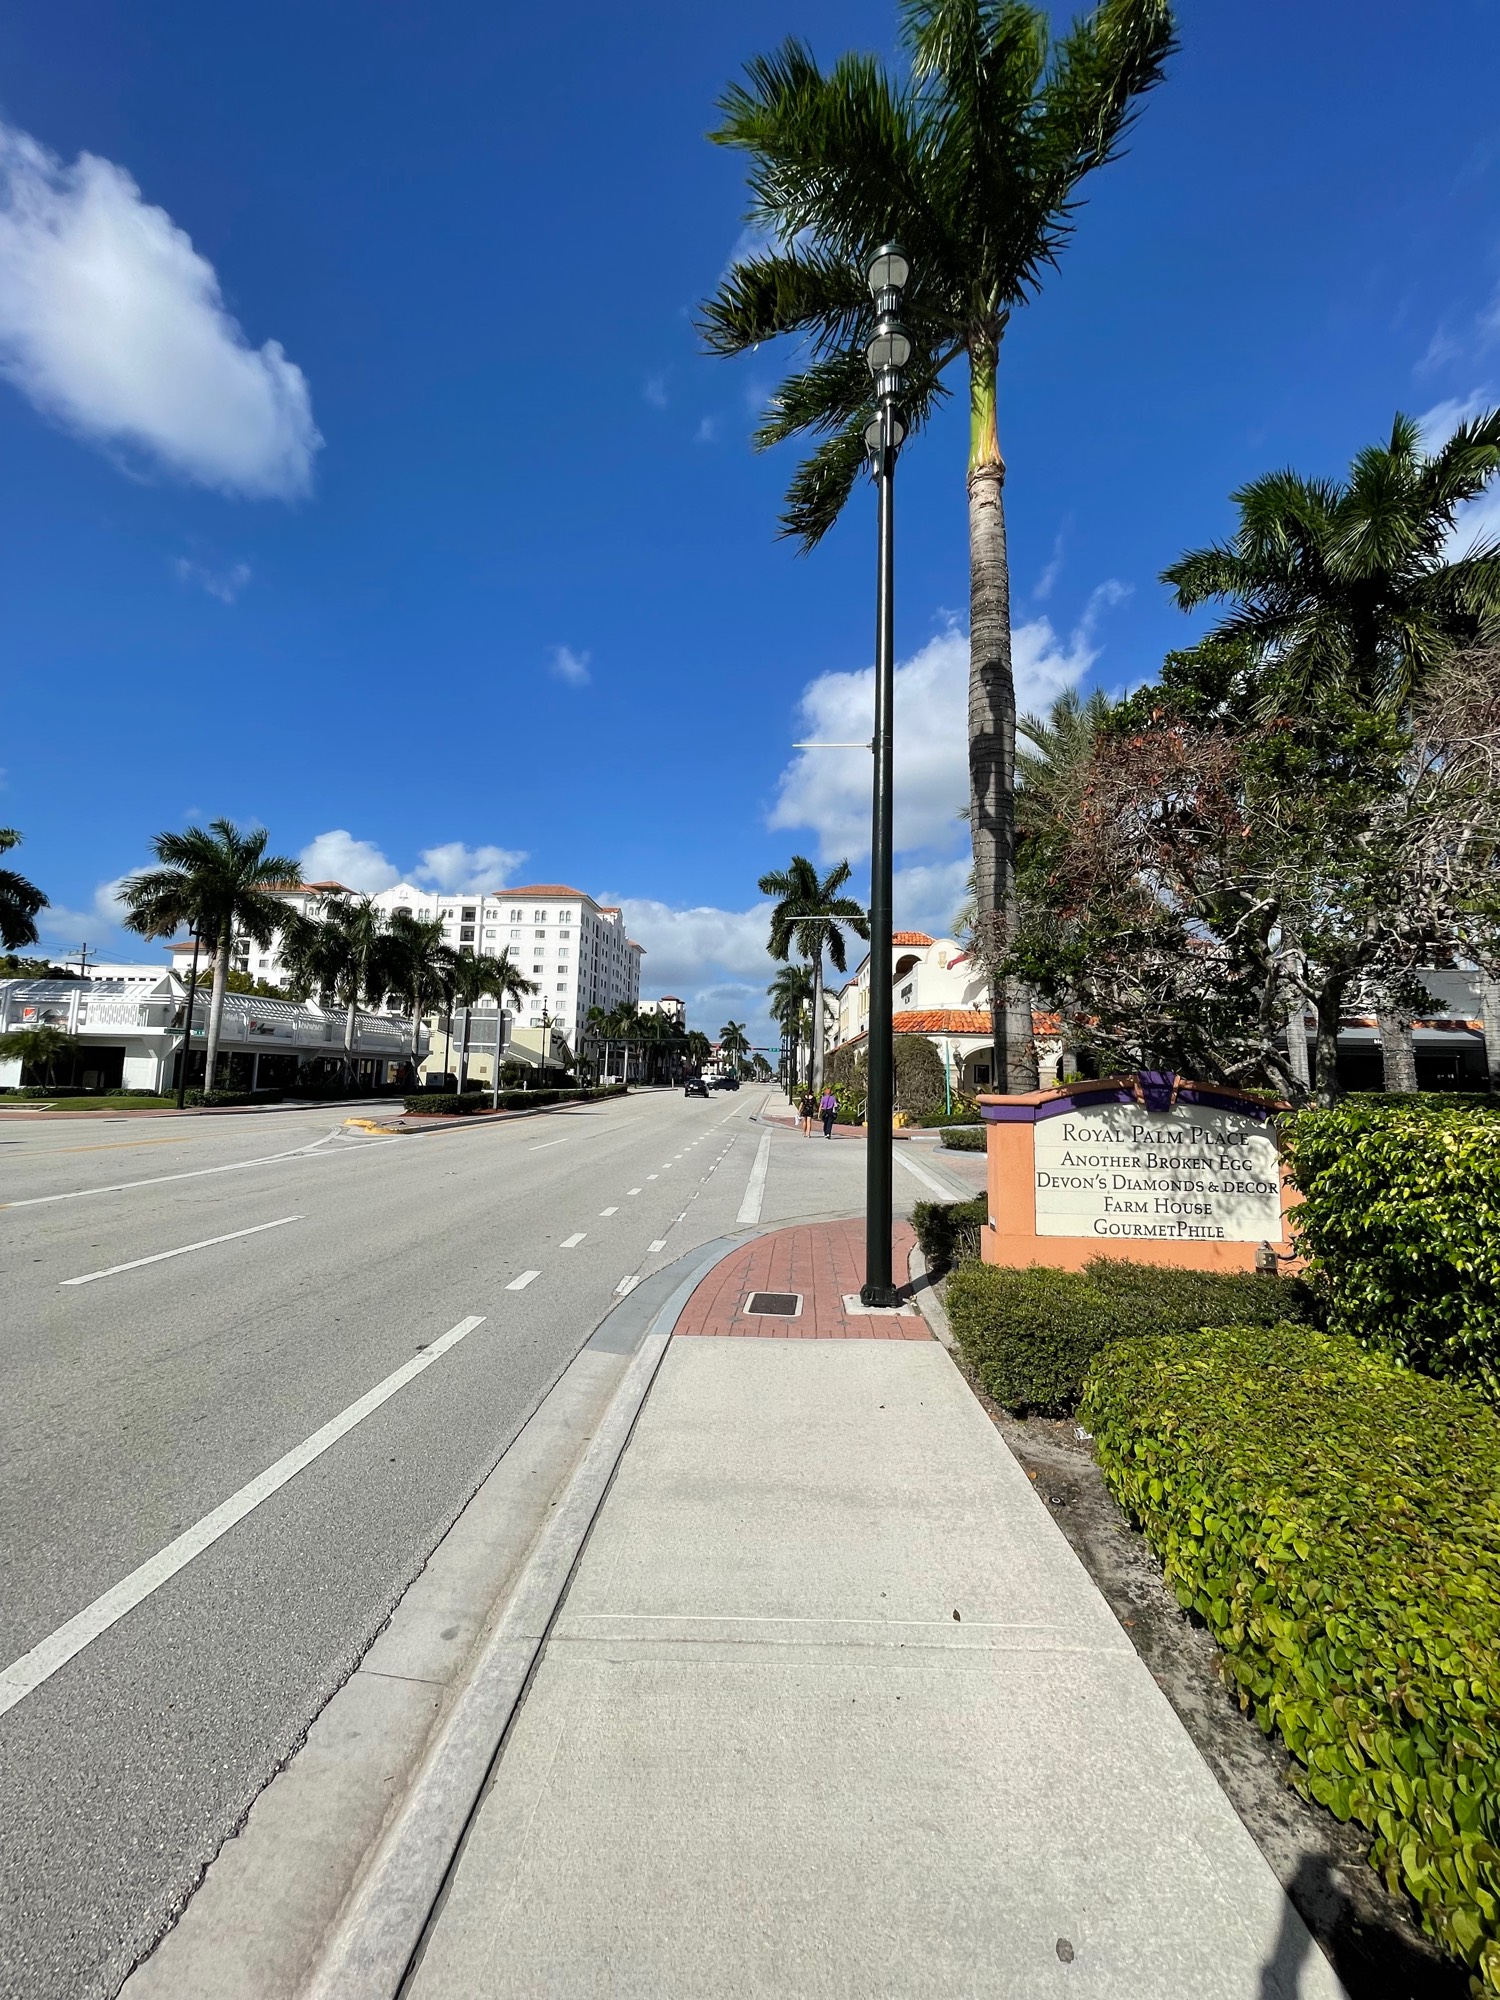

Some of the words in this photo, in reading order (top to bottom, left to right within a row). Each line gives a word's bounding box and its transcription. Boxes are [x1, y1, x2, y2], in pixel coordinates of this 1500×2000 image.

[1063, 1124, 1124, 1142] ROYAL
[1132, 1125, 1182, 1144] PALM
[1190, 1127, 1249, 1146] PLACE
[1061, 1151, 1140, 1168] ANOTHER
[1147, 1153, 1212, 1169] BROKEN
[1220, 1155, 1252, 1170] EGG
[1037, 1172, 1107, 1189] DEVON'S
[1113, 1175, 1204, 1192] DIAMONDS
[1208, 1183, 1219, 1192] &
[1222, 1180, 1278, 1194] DECOR
[1104, 1197, 1148, 1213] FARM
[1154, 1198, 1212, 1214] HOUSE
